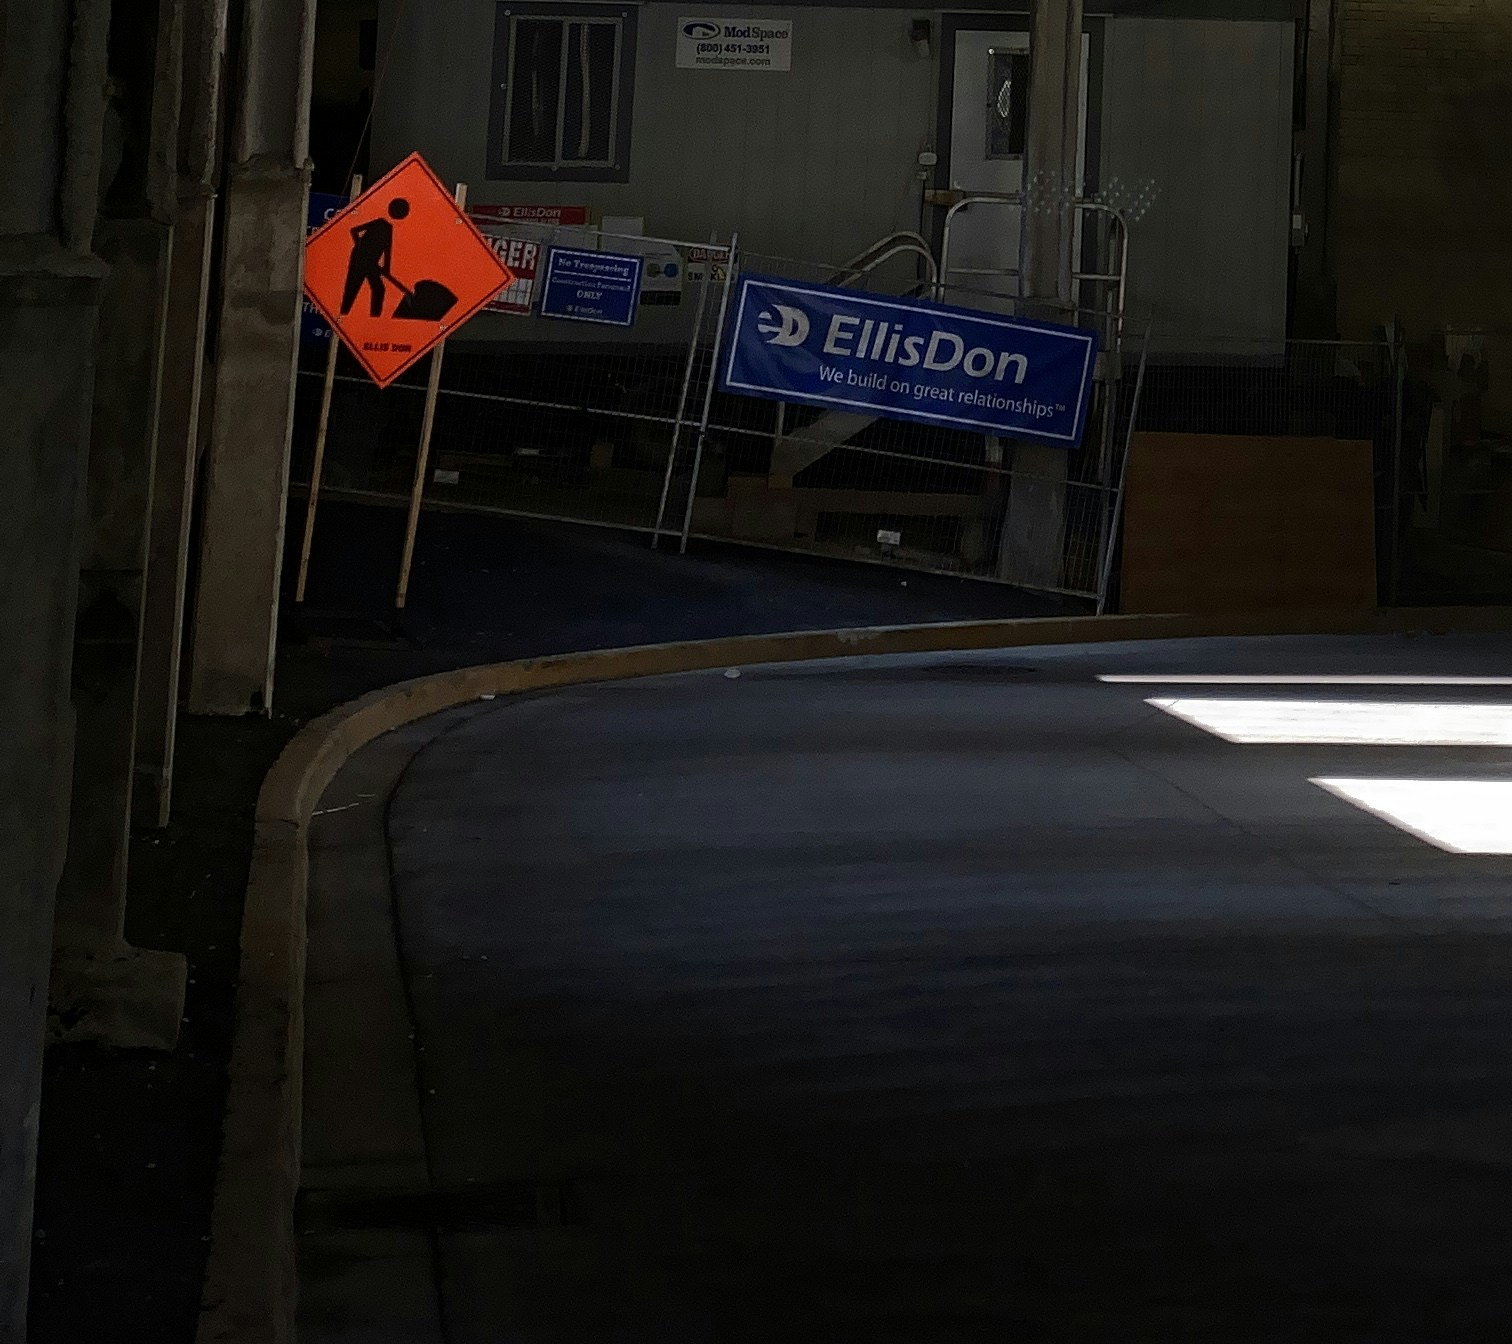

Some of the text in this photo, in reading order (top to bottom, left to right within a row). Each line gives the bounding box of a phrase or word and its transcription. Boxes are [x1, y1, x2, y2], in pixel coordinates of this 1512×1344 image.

[724, 26, 789, 41] ModSpace
[696, 43, 722, 55] (800)
[695, 54, 771, 67] modspace.com
[513, 207, 561, 219] EllisDon
[823, 314, 1028, 384] EllisDon
[818, 365, 845, 385] We
[847, 370, 888, 392] build
[889, 378, 911, 395] on
[913, 382, 955, 404] great
